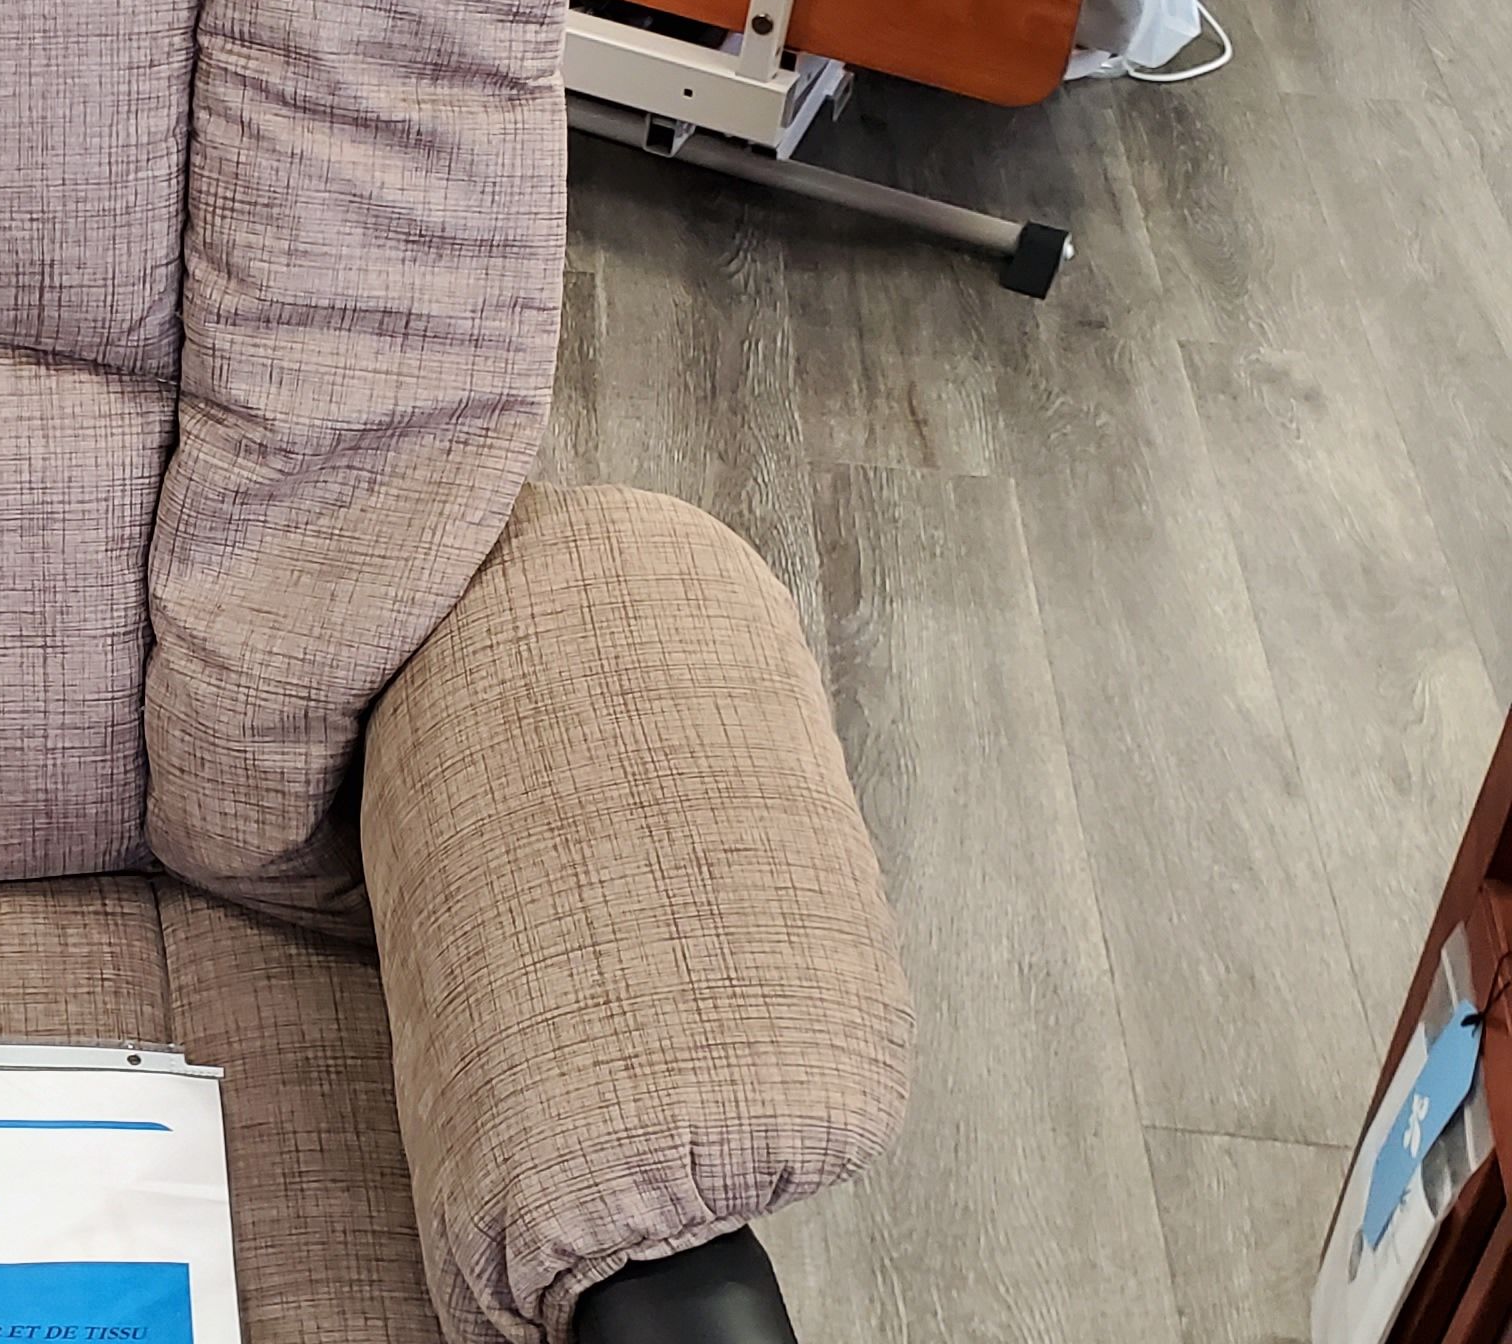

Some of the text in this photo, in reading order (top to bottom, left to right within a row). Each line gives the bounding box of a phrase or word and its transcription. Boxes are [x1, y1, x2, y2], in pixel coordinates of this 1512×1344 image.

[7, 1325, 41, 1339] ET
[44, 1325, 80, 1340] DE
[85, 1326, 148, 1340] TISSU
